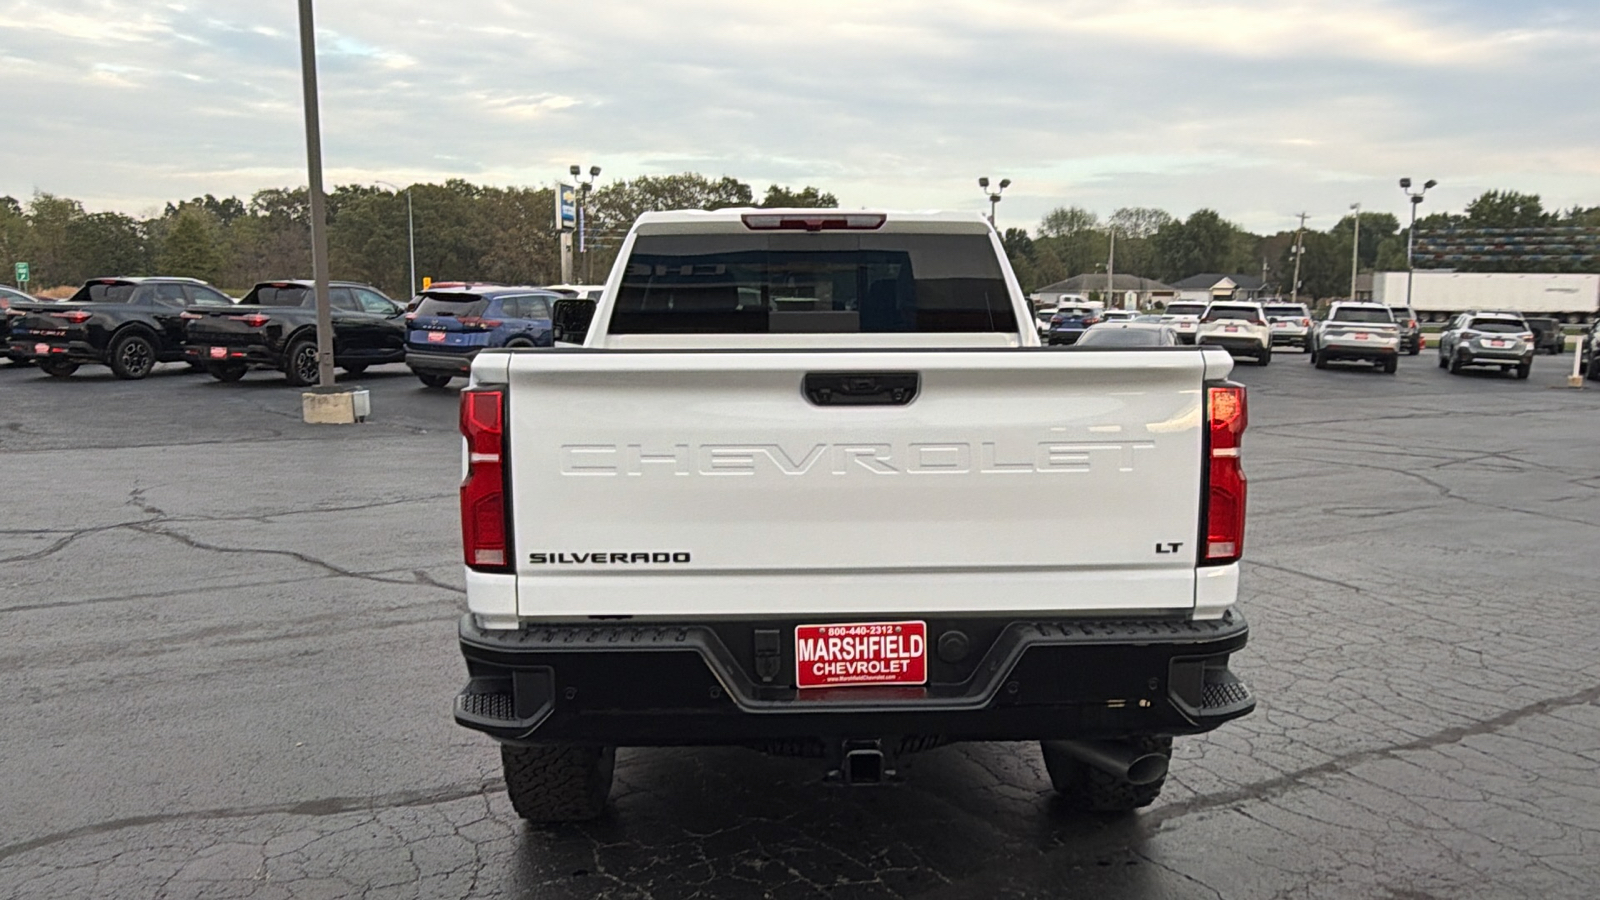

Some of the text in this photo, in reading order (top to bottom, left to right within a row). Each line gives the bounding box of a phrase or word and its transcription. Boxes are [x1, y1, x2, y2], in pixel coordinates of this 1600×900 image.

[560, 440, 1156, 477] CHEVROLET
[1155, 542, 1184, 554] LT
[529, 552, 691, 564] SILVERADO
[828, 625, 893, 636] 800-440-2312
[799, 634, 924, 662] MARSHFIELD
[812, 660, 910, 676] CHEVROLET
